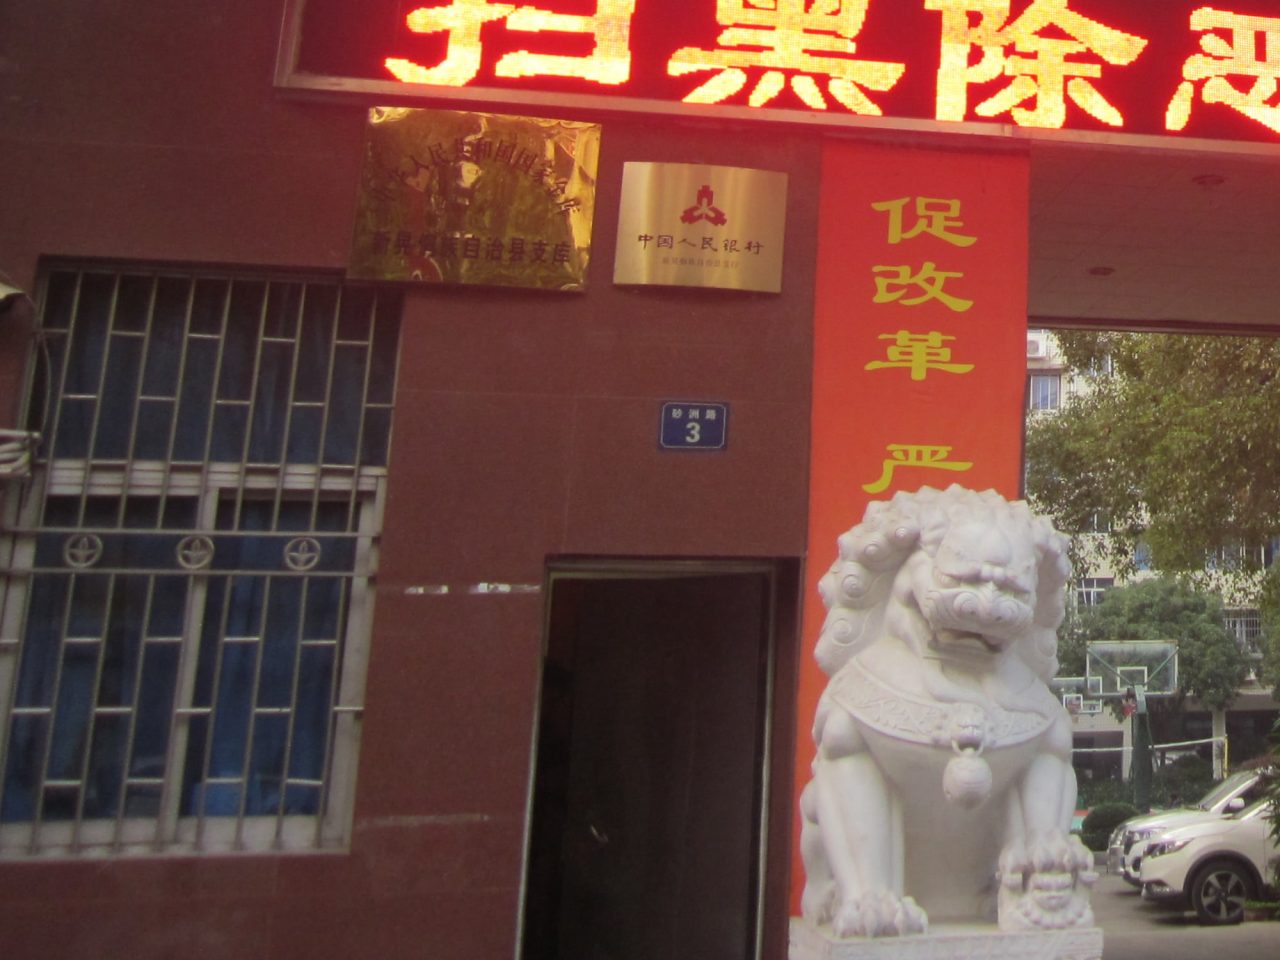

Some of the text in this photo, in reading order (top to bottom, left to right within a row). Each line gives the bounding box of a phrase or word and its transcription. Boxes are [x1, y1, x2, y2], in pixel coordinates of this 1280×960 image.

[638, 234, 765, 256] 中国人民银行
[863, 196, 978, 381] 促改革
[685, 422, 701, 443] 3
